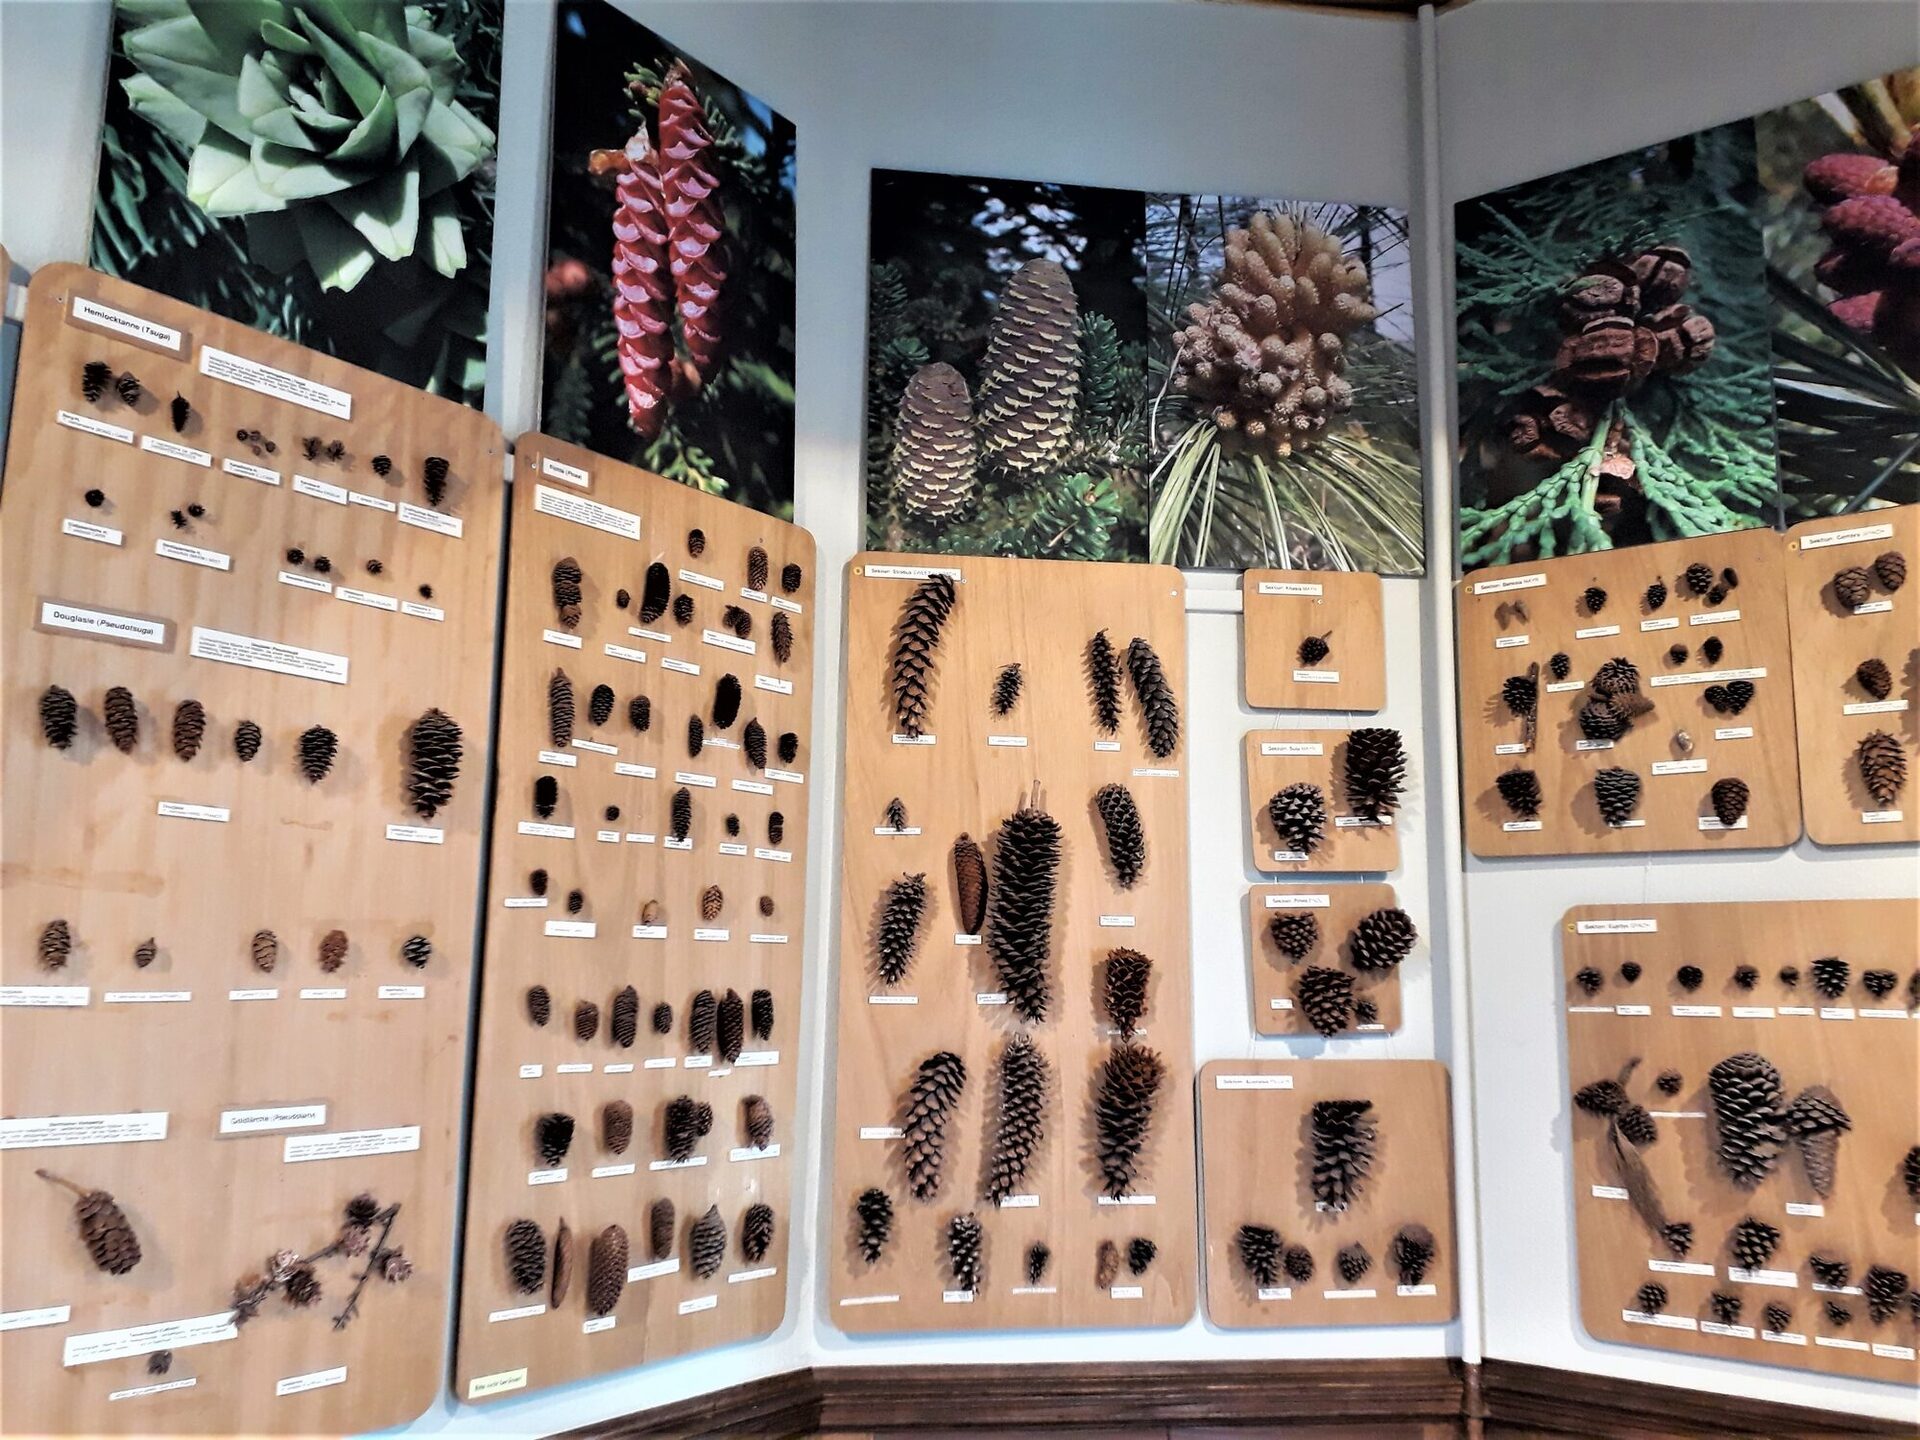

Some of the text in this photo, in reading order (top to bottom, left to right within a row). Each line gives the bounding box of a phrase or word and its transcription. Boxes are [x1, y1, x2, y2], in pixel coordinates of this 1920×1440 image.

[83, 306, 171, 341] Hemlocktanne (Tsuga)
[53, 611, 154, 635] Douglasie (Pseudotsuga)
